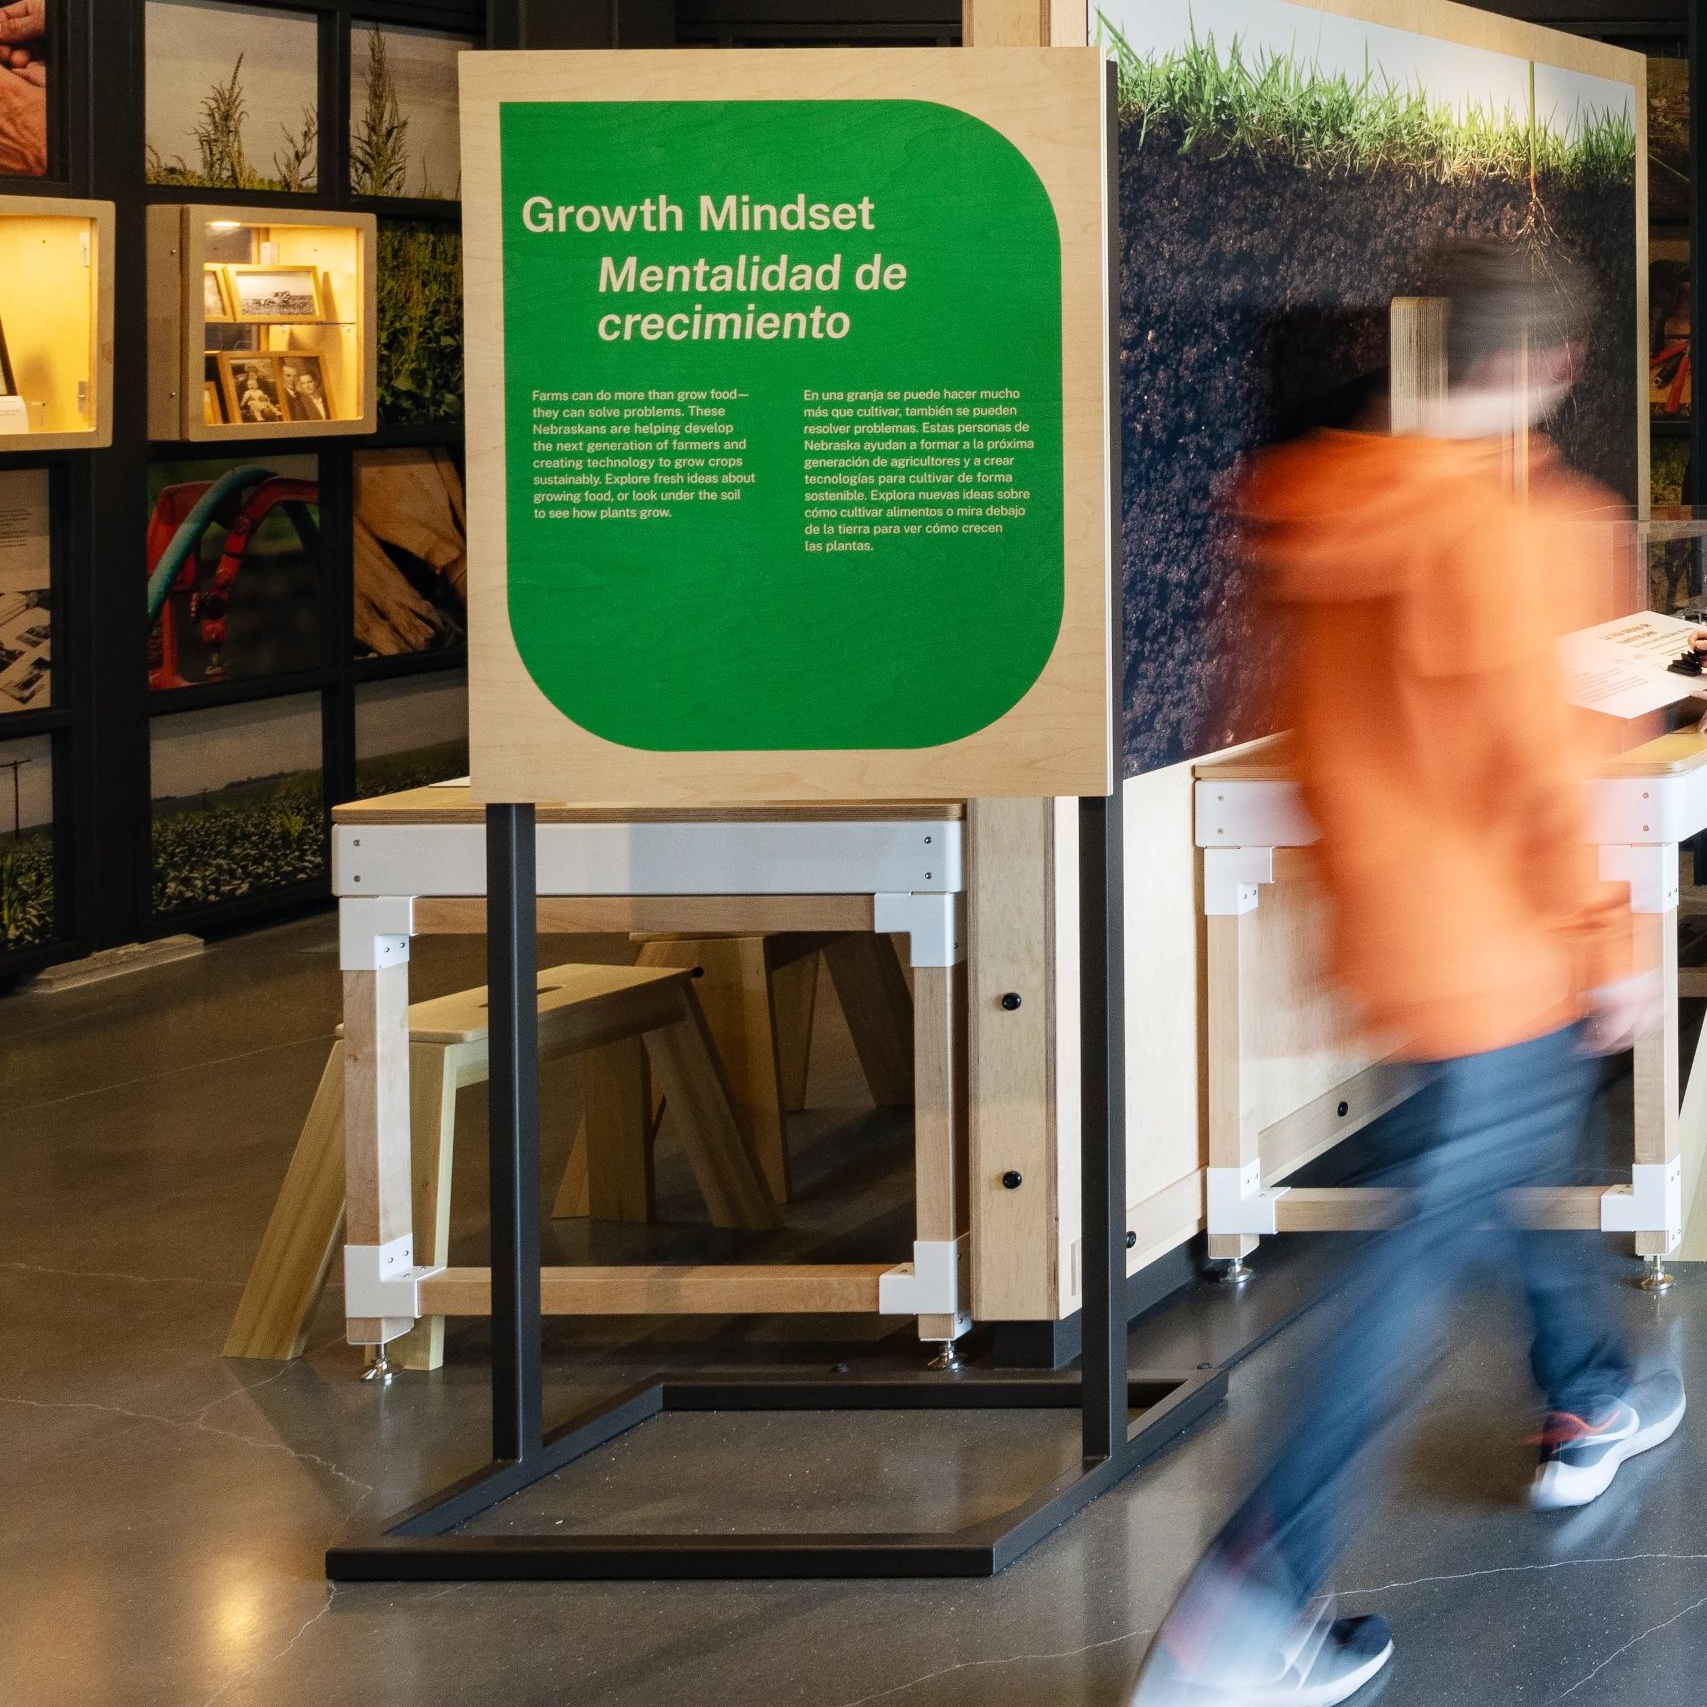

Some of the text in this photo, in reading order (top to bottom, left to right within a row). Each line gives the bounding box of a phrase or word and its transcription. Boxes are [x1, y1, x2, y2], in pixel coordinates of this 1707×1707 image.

[523, 194, 874, 232] Growth Mindset
[599, 254, 906, 292] Mentalidad de
[599, 304, 850, 340] crecimiento
[533, 390, 568, 401] Farms
[596, 390, 611, 400] do
[615, 392, 645, 400] more
[648, 390, 674, 400] than
[677, 391, 707, 402] grow
[710, 389, 748, 399] food—
[804, 388, 1020, 402] En una granja se puede hacer mucho
[533, 405, 725, 419] they can solve problems. These
[804, 405, 1017, 418] más que cultivar, también se pueden
[533, 422, 733, 435] Nebraskans are helping develop
[804, 421, 1029, 435] resolver problemas. Estas personas de
[533, 439, 746, 453] the next generation of farmers and
[805, 439, 1034, 452] Nebraska ayudan a formar a la próxima
[534, 457, 742, 470] creating technology to grow crops
[534, 473, 755, 486] sustainably. Explore fresh ideas about
[534, 489, 740, 504] growing food, or look under the soil
[534, 507, 671, 519] to see how plants grow.
